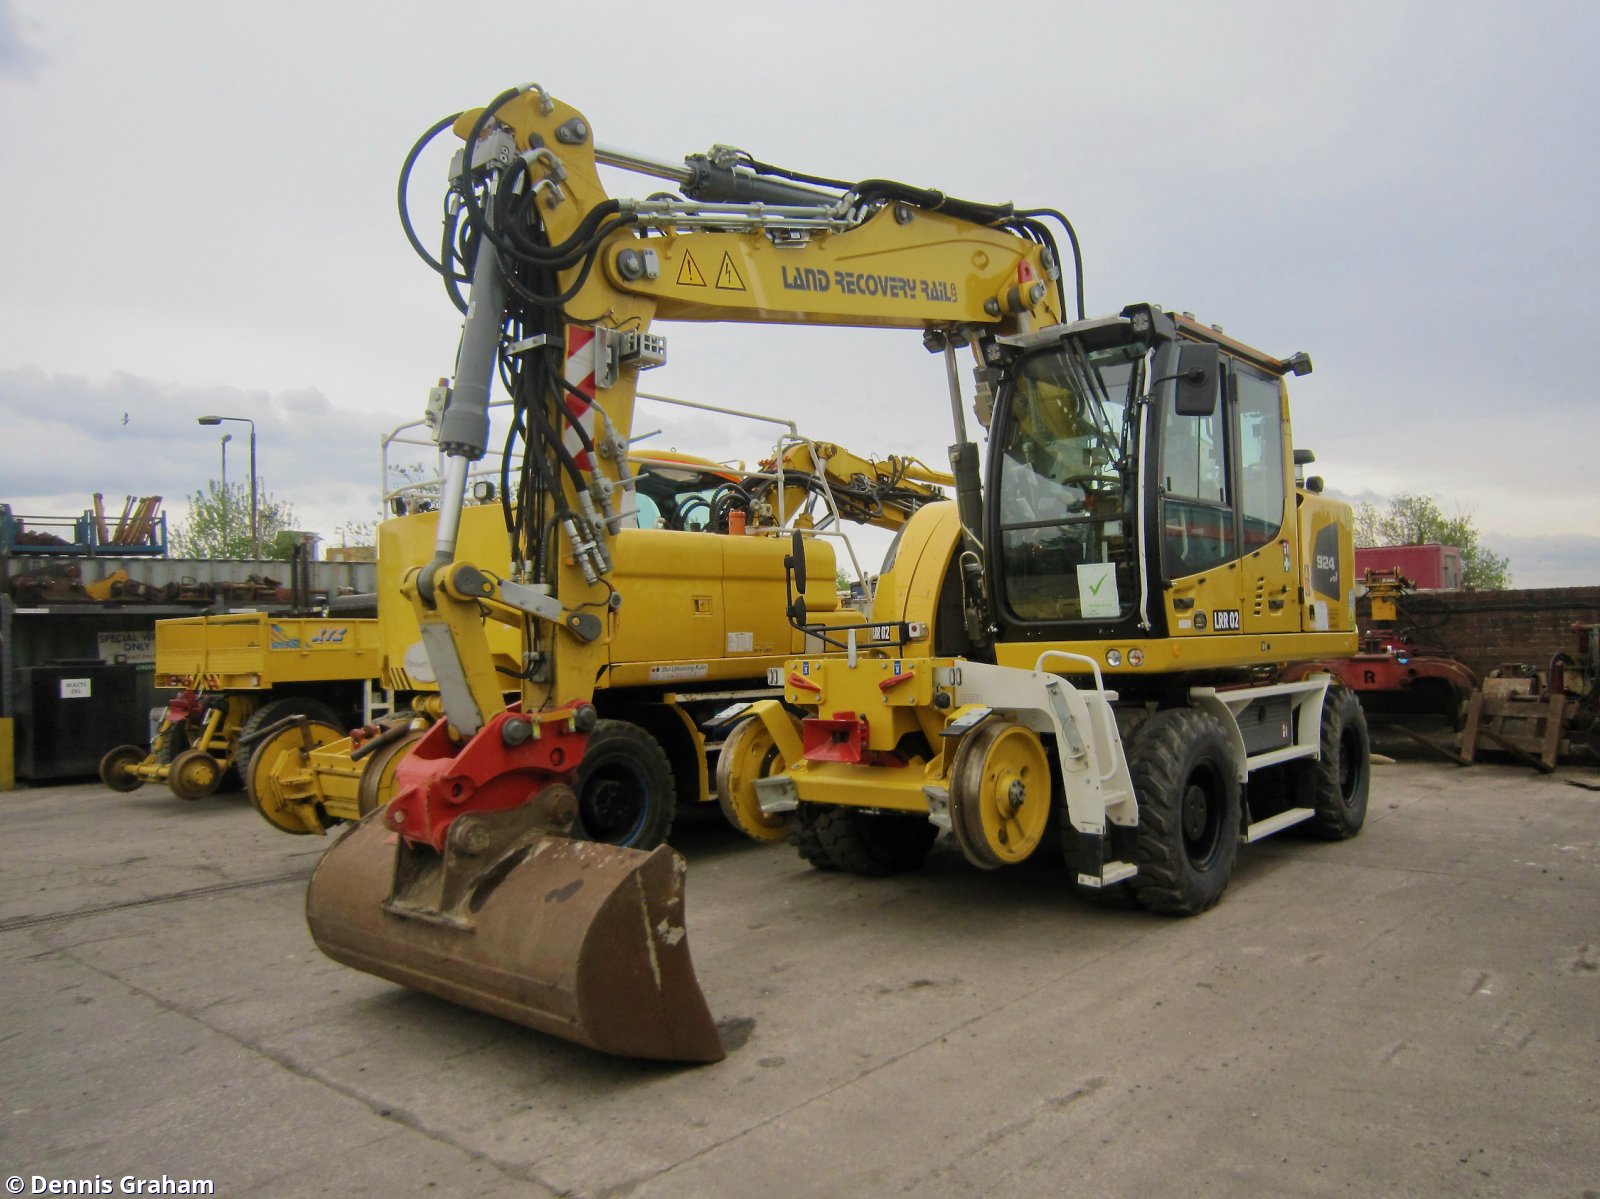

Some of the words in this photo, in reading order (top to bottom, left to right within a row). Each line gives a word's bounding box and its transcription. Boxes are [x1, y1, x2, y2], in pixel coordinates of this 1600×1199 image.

[781, 265, 831, 292] LAND
[834, 270, 917, 300] RECOVERY
[920, 279, 952, 303] RAIL
[1316, 555, 1335, 570] 924
[1213, 611, 1229, 629] LRR
[1229, 611, 1239, 628] 02
[99, 632, 139, 643] SPECIAL
[881, 625, 890, 640] 02
[123, 641, 151, 651] ONLY
[1363, 670, 1375, 684] R
